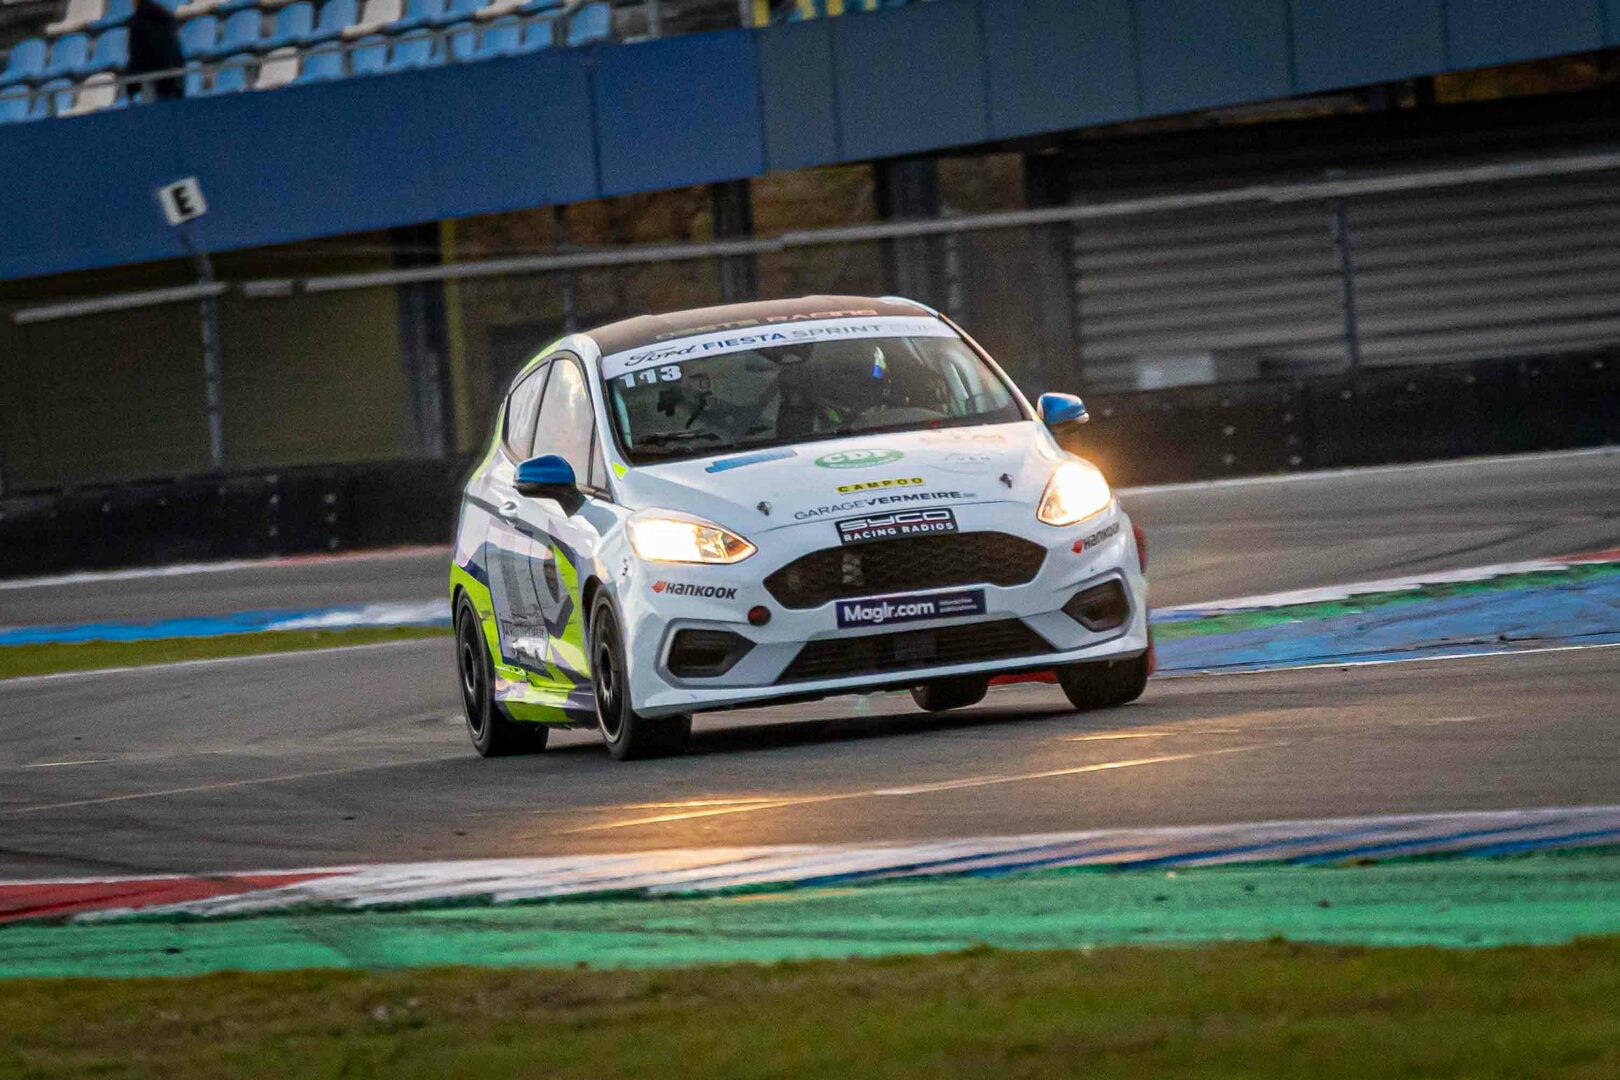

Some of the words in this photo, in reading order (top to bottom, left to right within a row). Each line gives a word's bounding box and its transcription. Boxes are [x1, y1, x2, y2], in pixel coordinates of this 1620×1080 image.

[171, 186, 194, 216] E
[624, 343, 699, 367] Ford
[702, 332, 787, 351] FIESTA
[792, 324, 882, 338] SPRINT
[618, 365, 683, 389] 113
[838, 477, 924, 493] CAMPOO
[839, 510, 951, 532] SYCO
[843, 527, 897, 542] RACING
[901, 522, 955, 534] RADIOS
[844, 601, 935, 623] Maglr.com
